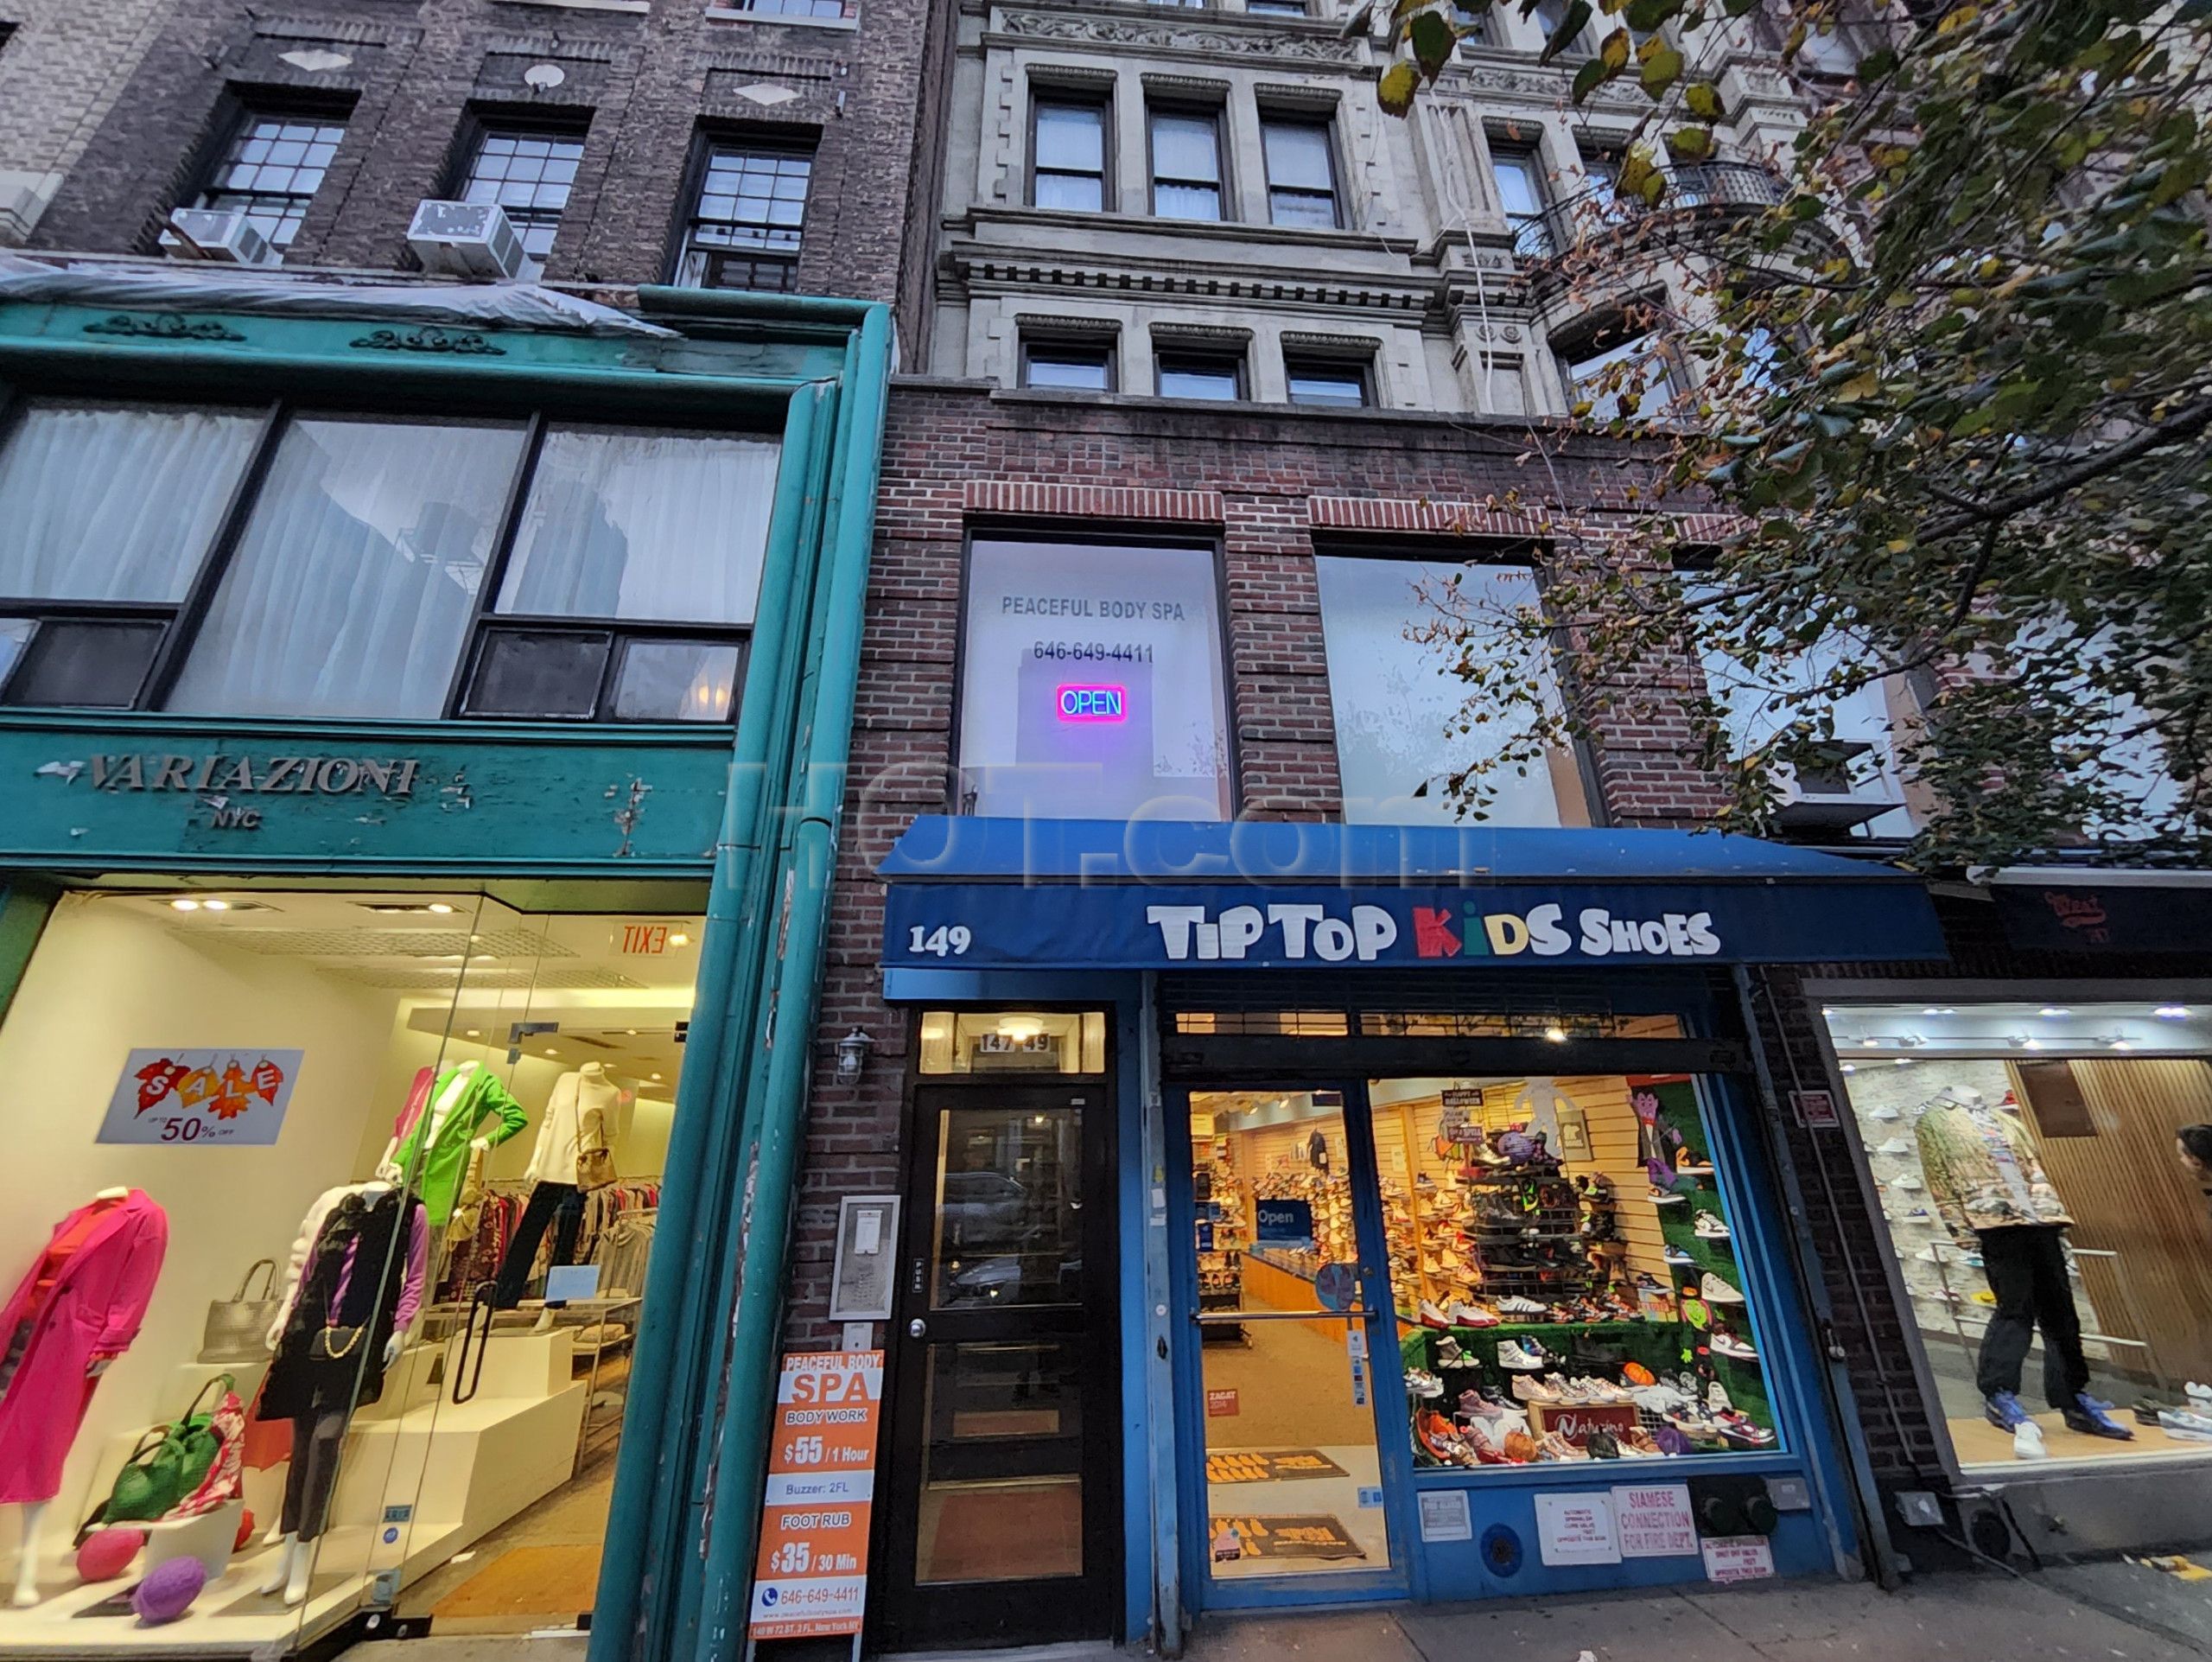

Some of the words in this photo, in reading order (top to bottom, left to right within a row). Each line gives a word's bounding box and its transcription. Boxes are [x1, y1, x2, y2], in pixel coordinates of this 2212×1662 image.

[1002, 596, 1092, 617] PEACEFUL
[1099, 601, 1147, 619] BODY
[1151, 602, 1185, 621] SPA
[1033, 641, 1154, 664] 646-649-4411
[1060, 691, 1122, 716] OPEN
[91, 754, 419, 793] VARIAZIONI
[211, 809, 258, 828] NYC
[909, 926, 971, 957] 149
[1580, 908, 1720, 956] SHOES
[146, 1070, 276, 1098] SALE
[161, 1118, 216, 1141] 50%
[1258, 1210, 1294, 1226] Open
[785, 1356, 845, 1372] PEACEFUL
[848, 1354, 880, 1370] BODY
[791, 1372, 869, 1404] SPA
[786, 1411, 823, 1424] BODY
[827, 1410, 867, 1422] WORK
[785, 1436, 823, 1464] $55
[842, 1447, 869, 1461] Hour
[785, 1484, 826, 1495] Buzzer:
[829, 1481, 849, 1493] 2FL
[1629, 1491, 1675, 1508] SIAMESE
[781, 1514, 818, 1528] FOOT
[823, 1513, 851, 1526] RUB
[1621, 1512, 1690, 1530] CONNECTION
[1624, 1534, 1642, 1551] FOR
[1643, 1532, 1666, 1550] FIRE
[771, 1543, 810, 1572] $35
[818, 1555, 833, 1570] 30
[836, 1554, 857, 1570] Min
[781, 1587, 859, 1605] 646-649-4411
